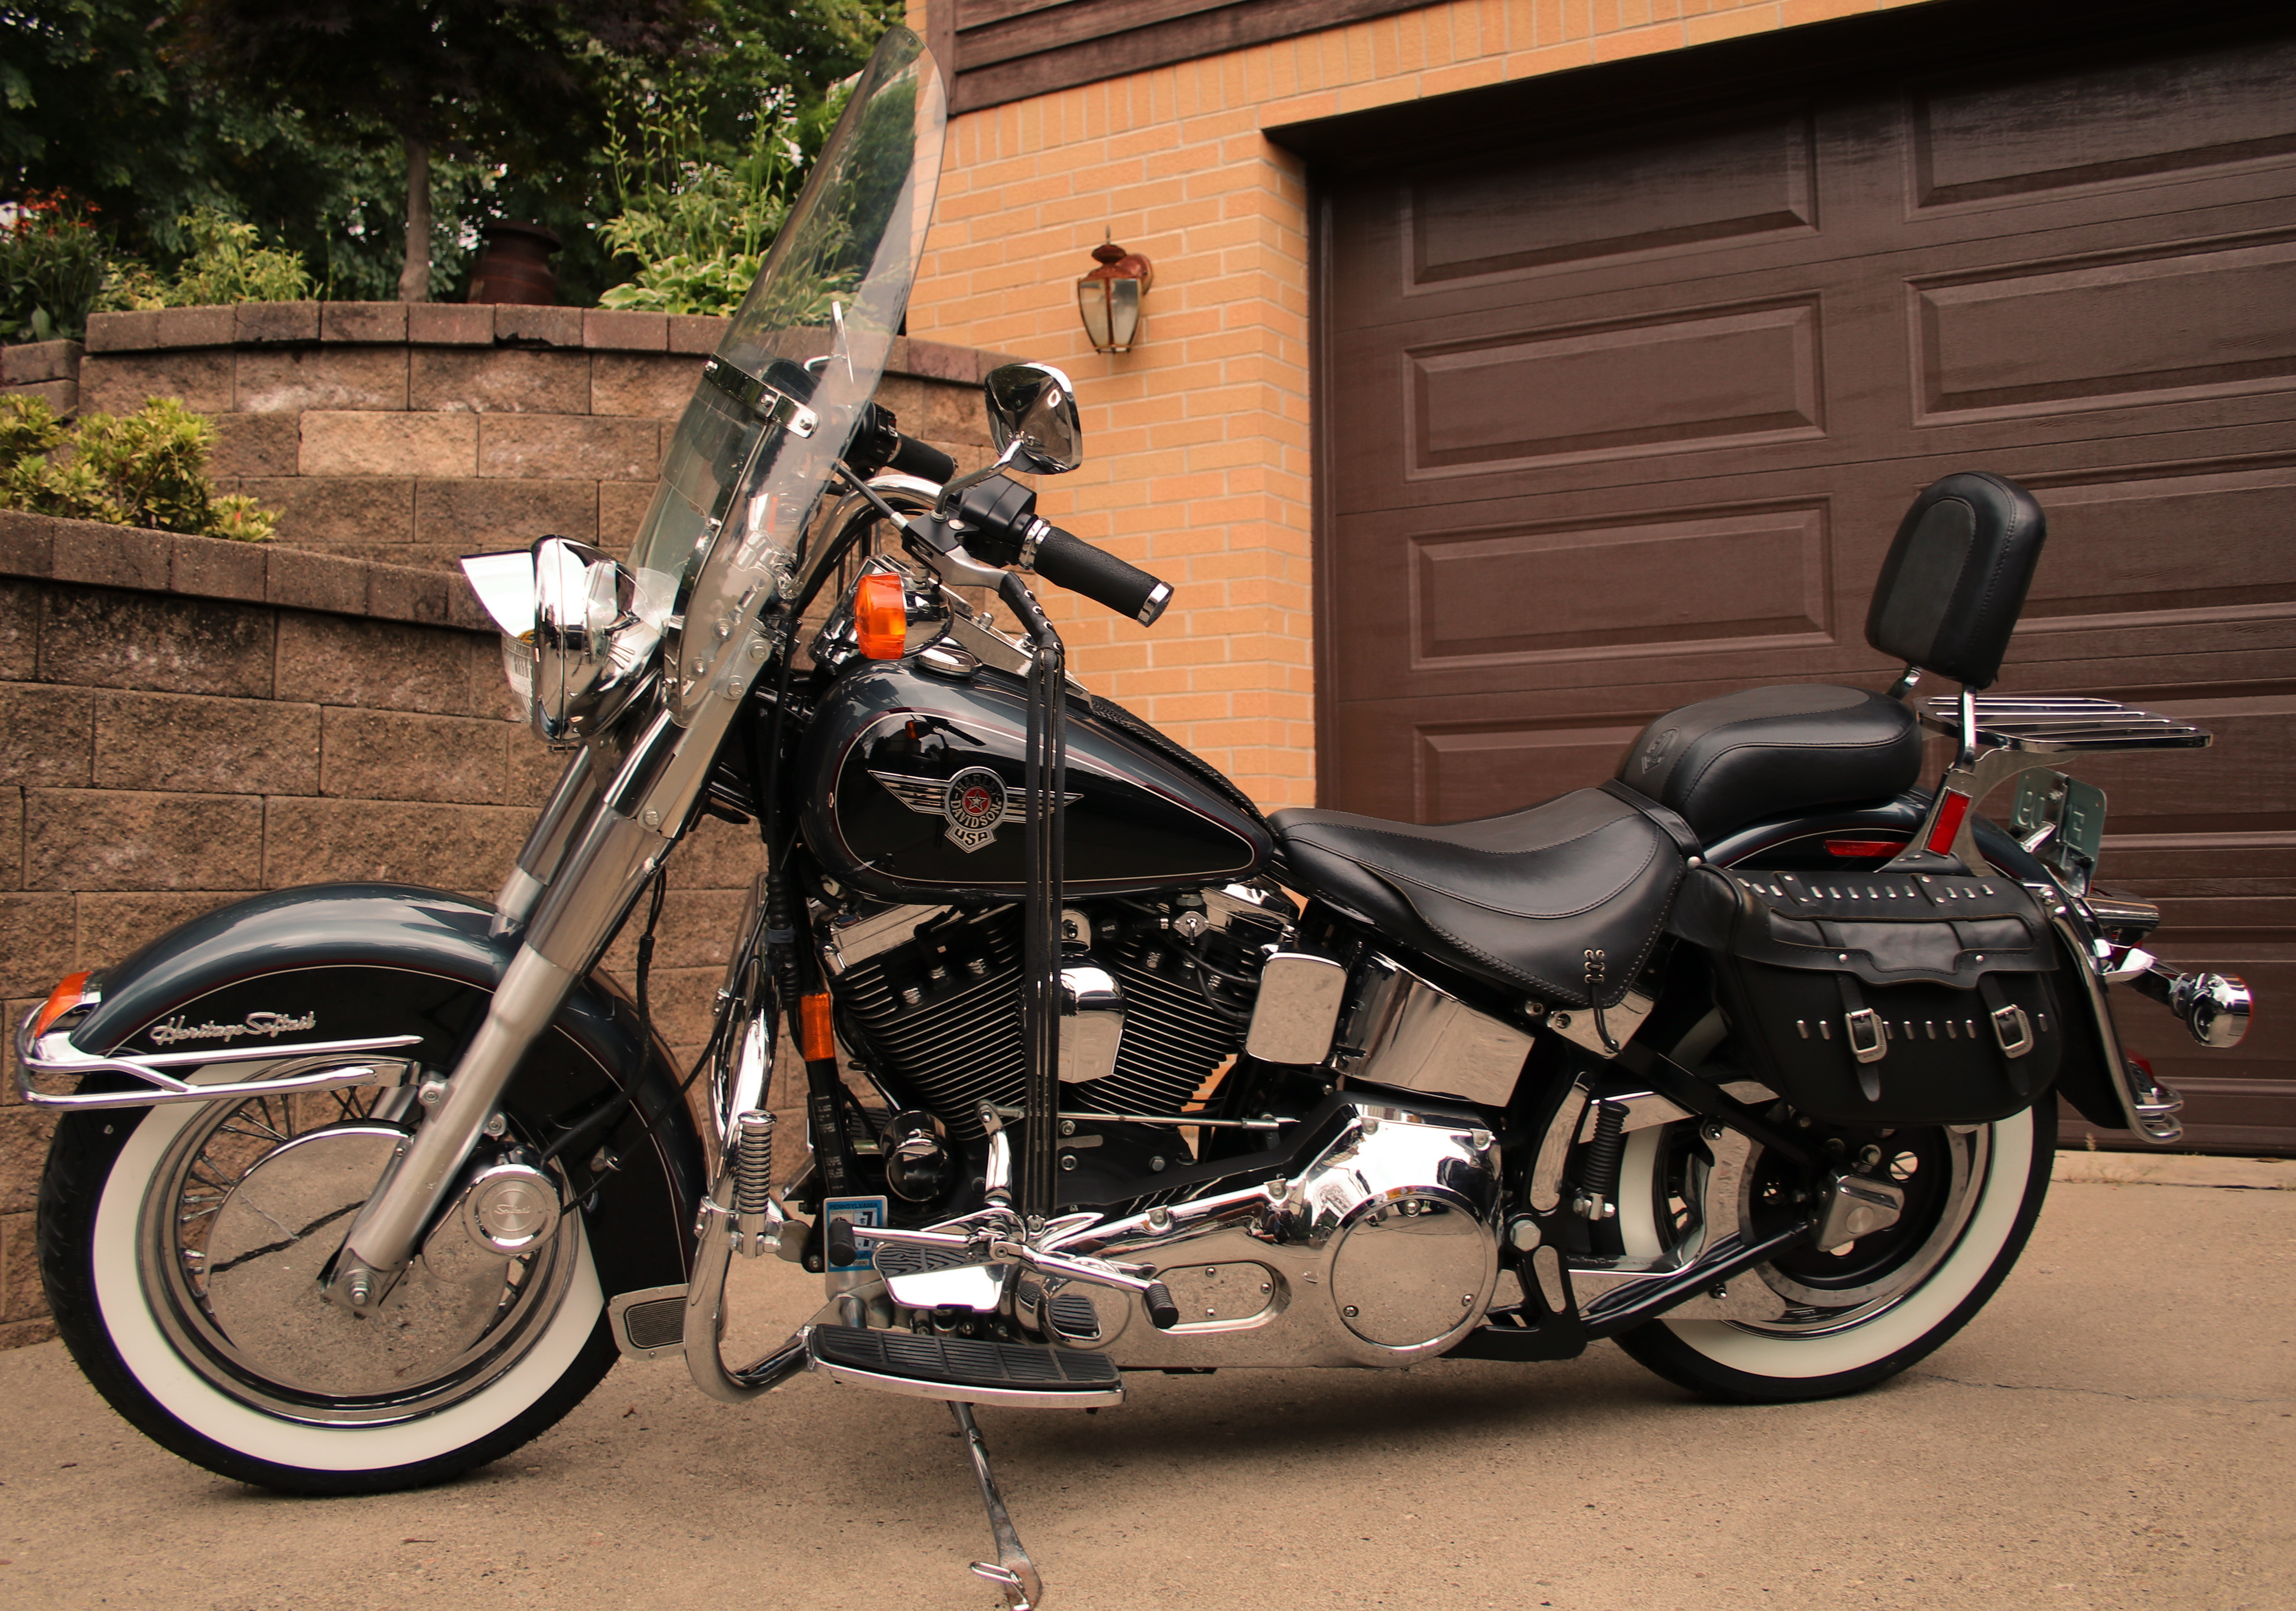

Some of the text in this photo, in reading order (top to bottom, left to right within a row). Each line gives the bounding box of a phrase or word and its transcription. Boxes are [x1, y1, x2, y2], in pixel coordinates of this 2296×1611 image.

[950, 800, 1002, 828] DAVIDSON
[954, 828, 989, 846] USA
[150, 1011, 317, 1045] Heritage Softail
